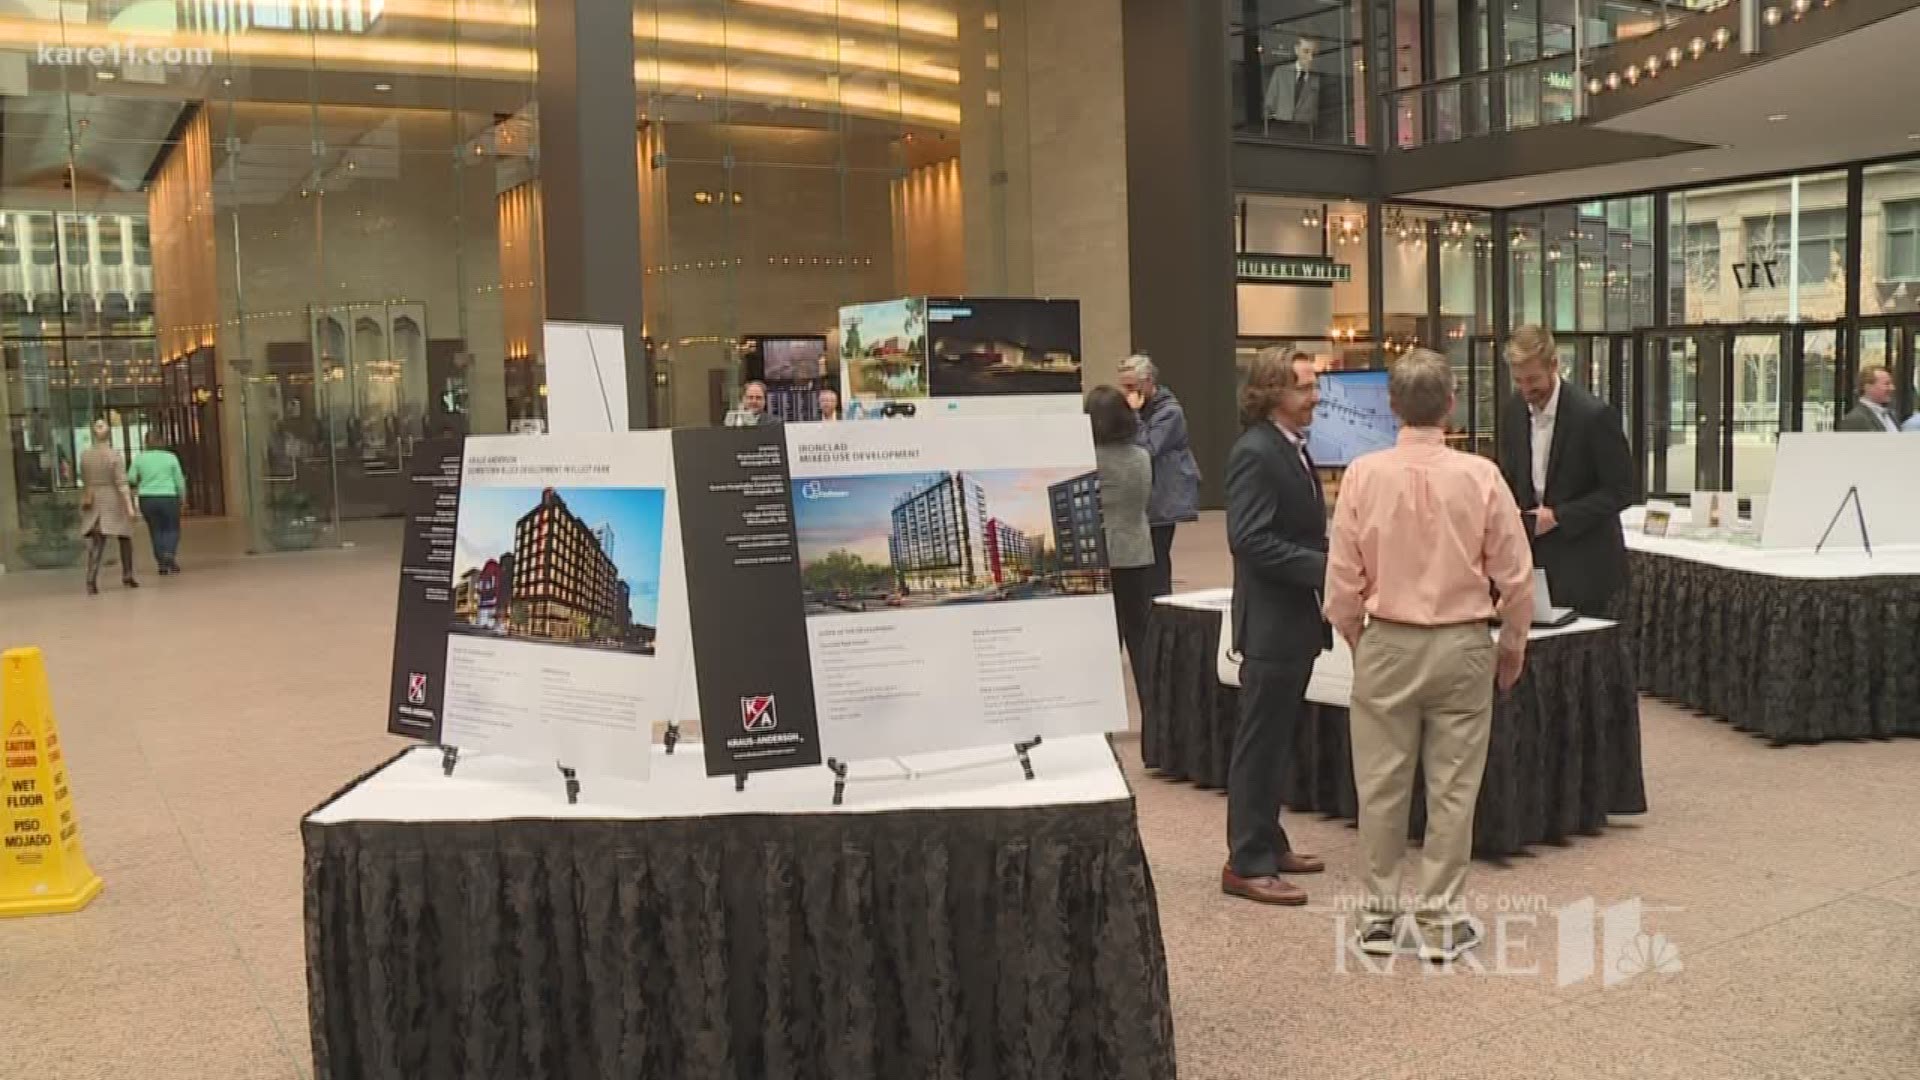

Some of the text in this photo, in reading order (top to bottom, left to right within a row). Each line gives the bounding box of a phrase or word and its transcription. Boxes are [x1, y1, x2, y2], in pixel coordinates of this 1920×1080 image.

[1237, 261, 1296, 277] HUBERT
[798, 443, 848, 453] IRONCLAD
[799, 448, 919, 463] MIXED USE DEVELOPMENT
[12, 779, 36, 792] WET
[7, 794, 44, 808] FLOOR
[14, 820, 39, 832] PISO
[5, 834, 51, 848] MOJADO
